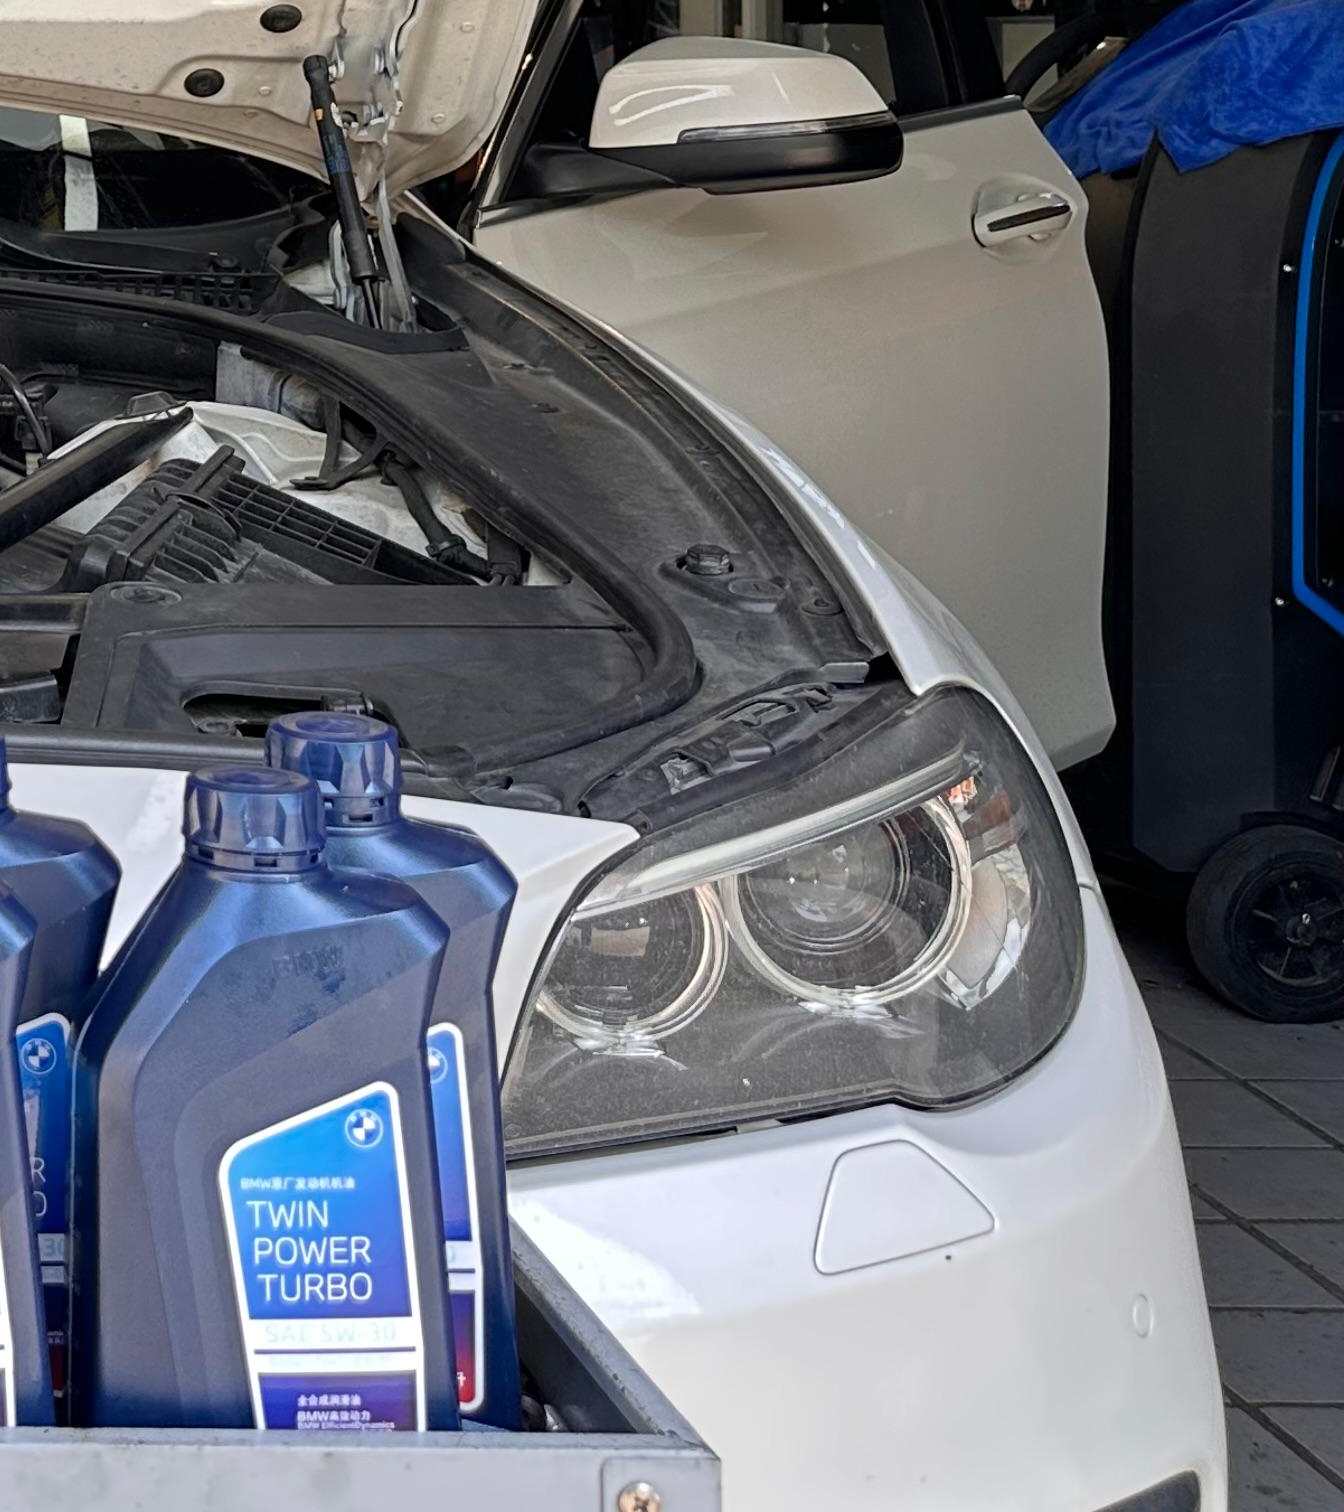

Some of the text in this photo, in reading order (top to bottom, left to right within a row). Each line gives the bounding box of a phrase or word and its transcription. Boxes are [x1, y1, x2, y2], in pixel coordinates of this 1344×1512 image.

[246, 1199, 329, 1229] TWIN
[254, 1235, 372, 1266] POWER
[257, 1271, 373, 1302] TURBO
